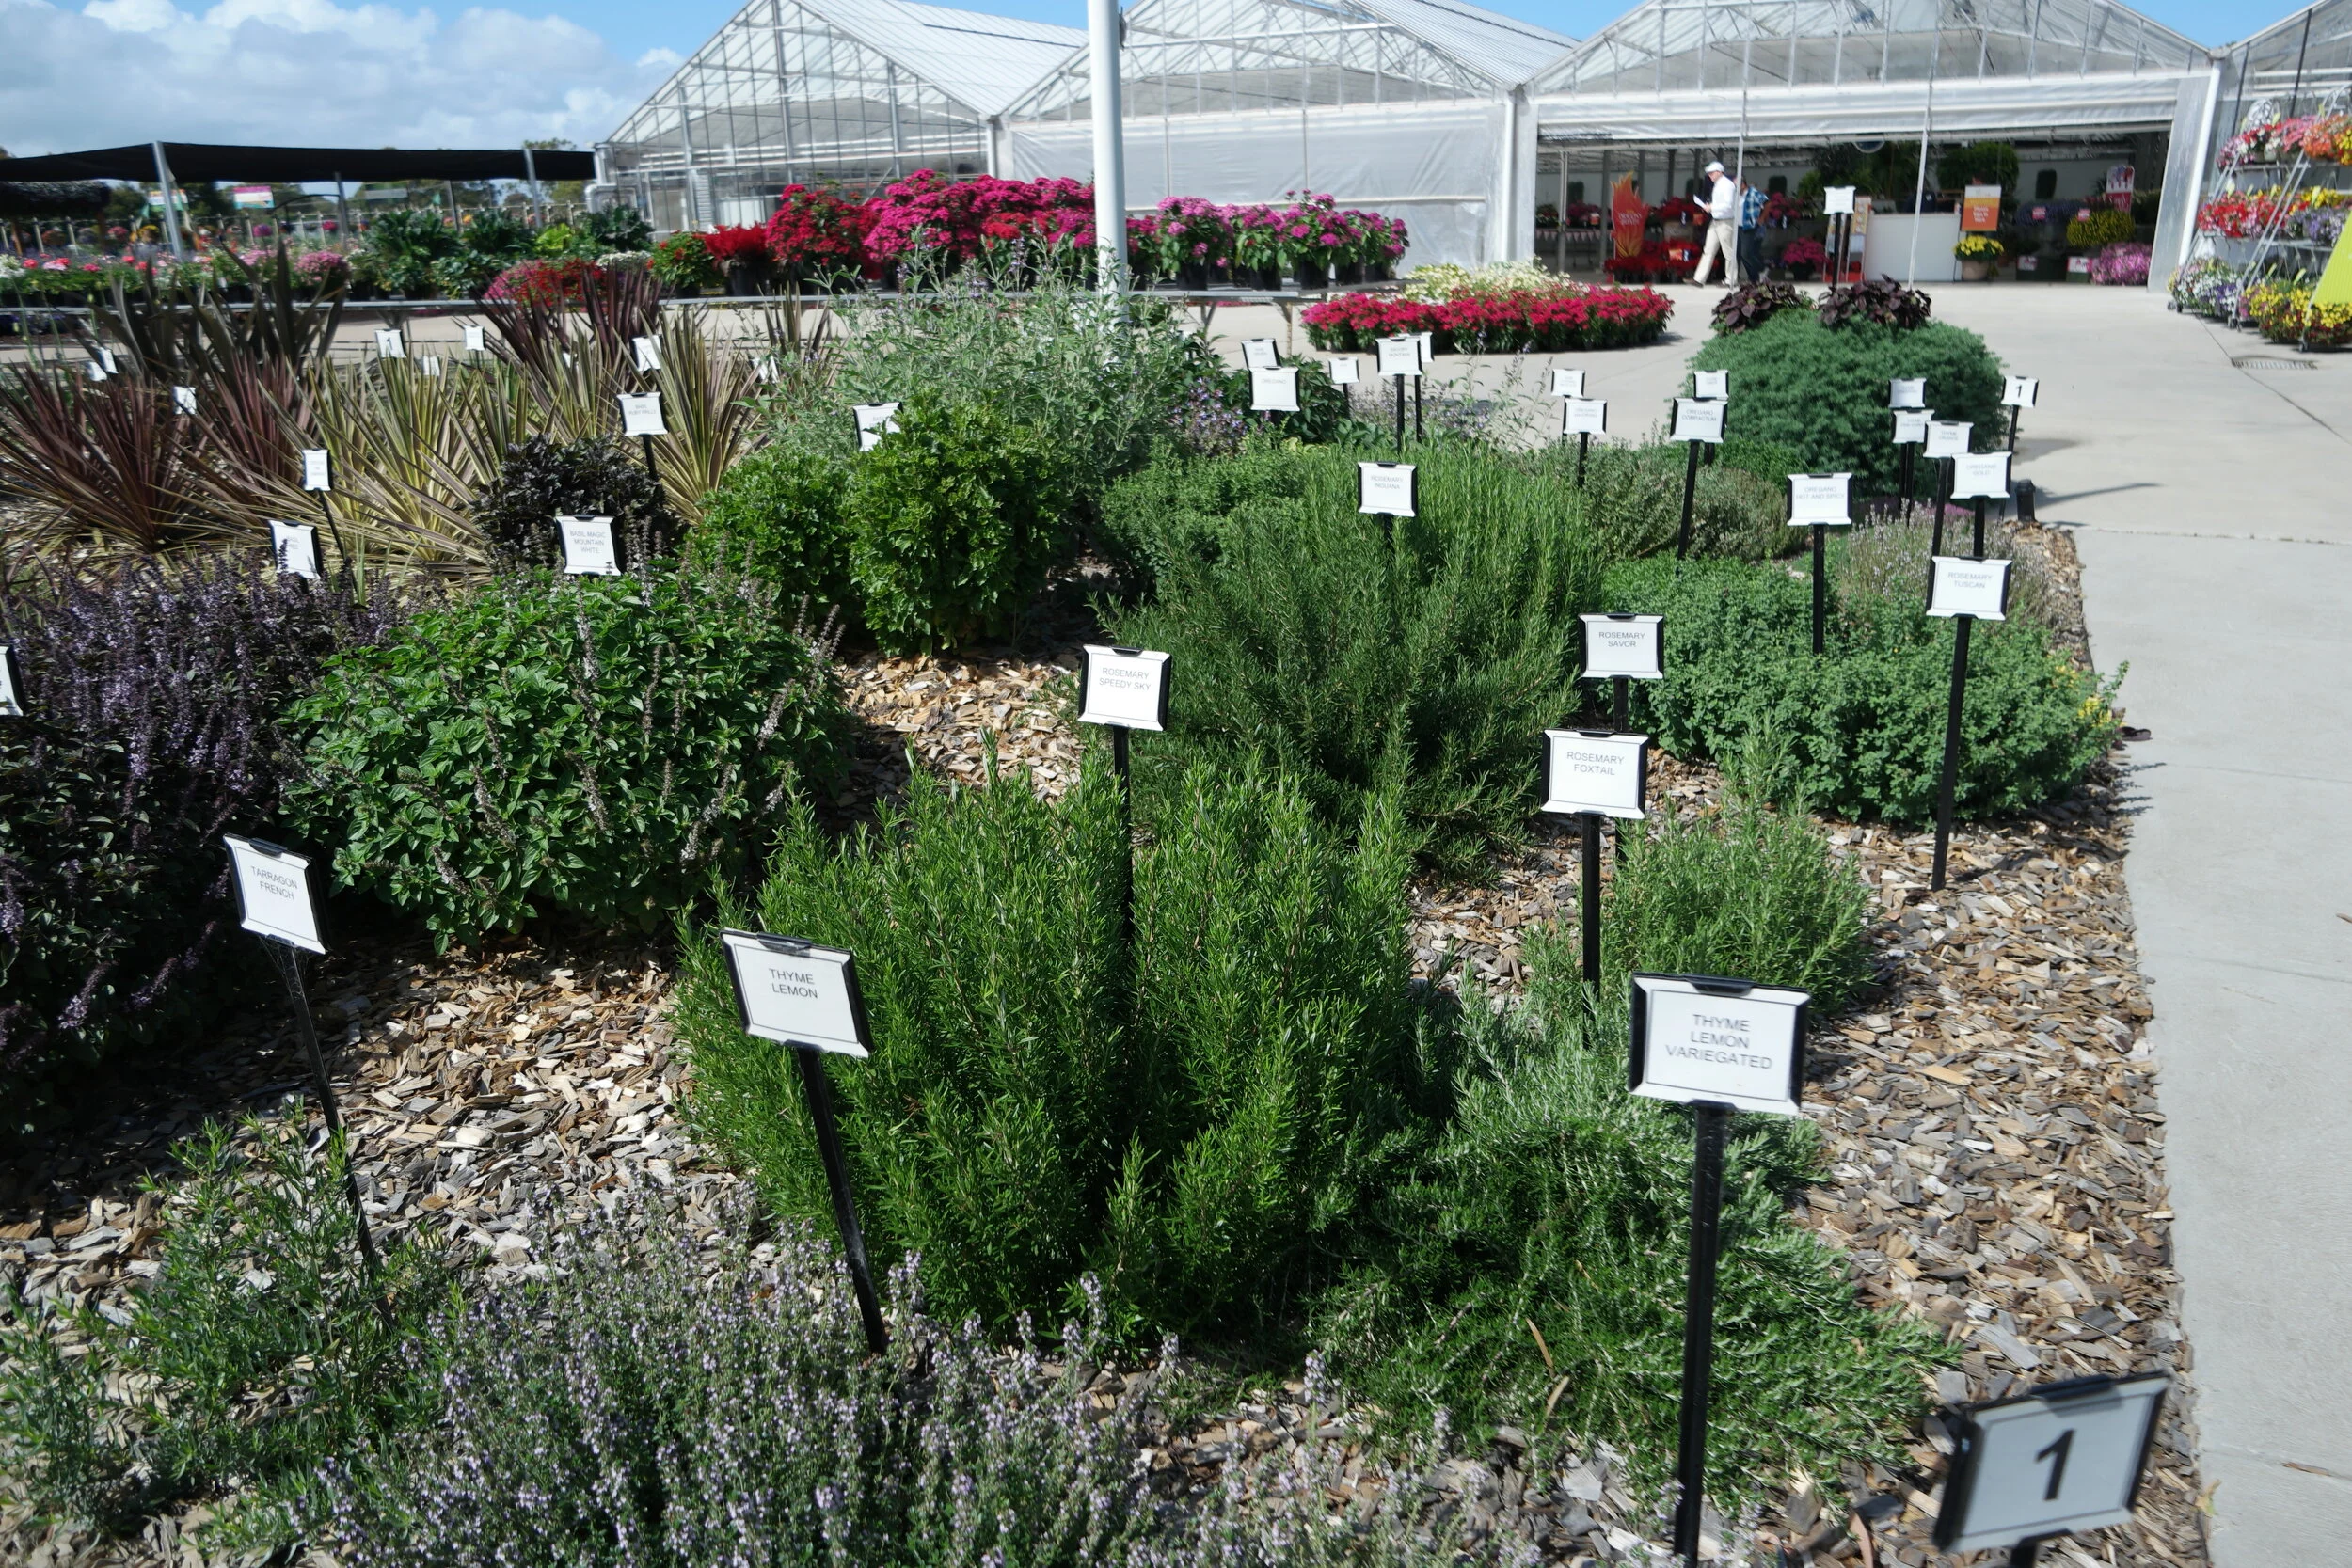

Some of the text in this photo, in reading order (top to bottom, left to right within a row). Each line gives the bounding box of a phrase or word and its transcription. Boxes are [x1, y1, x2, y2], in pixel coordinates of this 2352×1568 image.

[2016, 384, 2023, 398] 1
[569, 530, 607, 539] BASIL MAGIC
[573, 537, 605, 546] MOUNTAIN
[580, 546, 601, 554] WHITE
[1947, 571, 1994, 580] ROSEMARY
[1954, 580, 1986, 589] TUSCAN
[1598, 631, 1645, 640] ROSEMARY
[1607, 640, 1637, 648] SAVOR
[1102, 667, 1150, 680] ROSEMARY
[1099, 677, 1152, 691] SPEEDY SKY
[1566, 751, 1625, 765] ROSEMARY
[1573, 764, 1615, 776] FOXTAIL
[250, 865, 298, 890] TARRAGON
[260, 880, 294, 900] FRENCH
[768, 968, 816, 986] THYME
[771, 982, 819, 1000] LEMON
[1692, 1014, 1751, 1033] THYME
[1690, 1031, 1750, 1050] LEMON
[1665, 1044, 1773, 1069] VARIEGATED
[2033, 1428, 2077, 1502] 1
